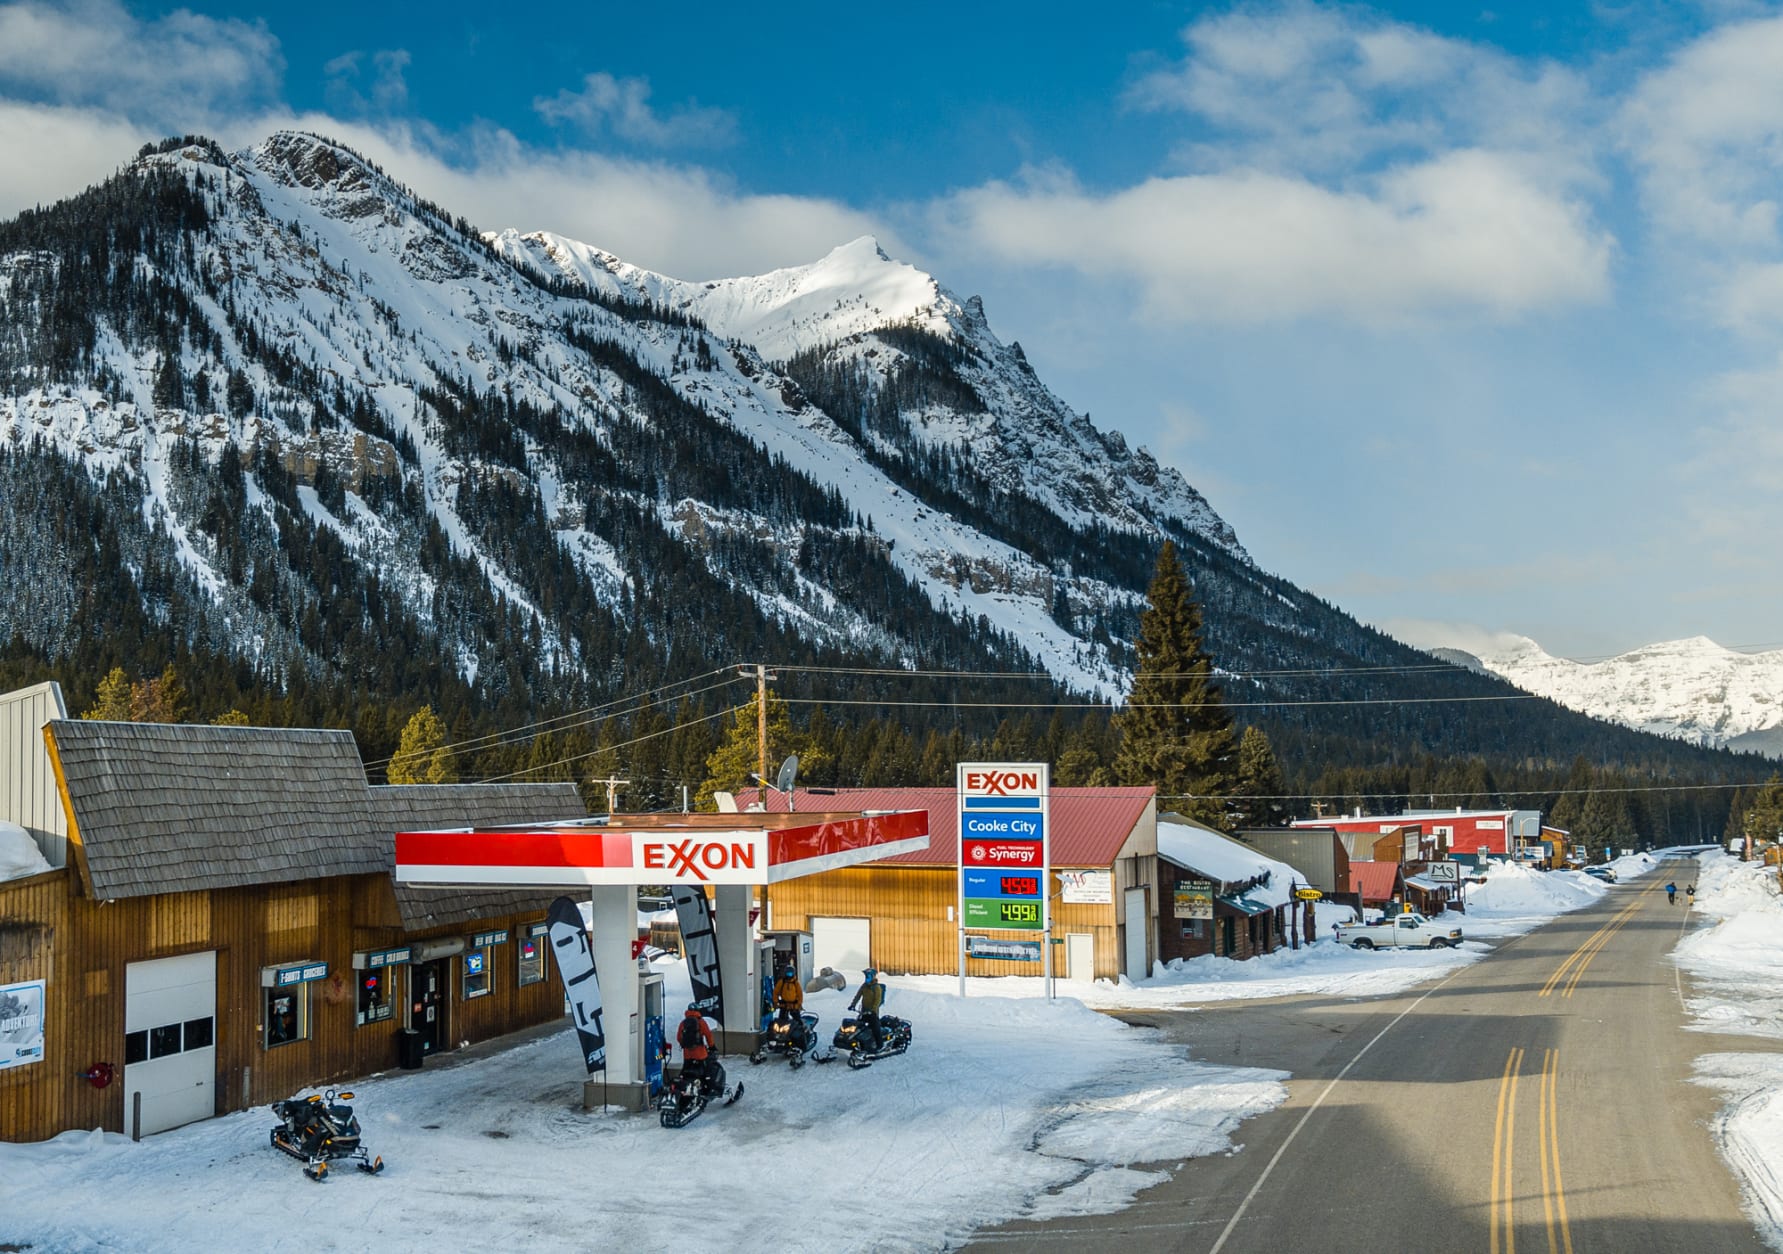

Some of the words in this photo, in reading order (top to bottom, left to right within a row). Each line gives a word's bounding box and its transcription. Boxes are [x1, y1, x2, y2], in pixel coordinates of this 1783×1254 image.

[967, 770, 1037, 796] EXXON
[968, 820, 1008, 832] Cooke
[1011, 820, 1036, 835] City
[643, 838, 755, 880] EXXON
[989, 847, 1035, 862] Synergy
[1298, 890, 1320, 898] Bistro
[2, 1014, 38, 1031] ADVENTURE
